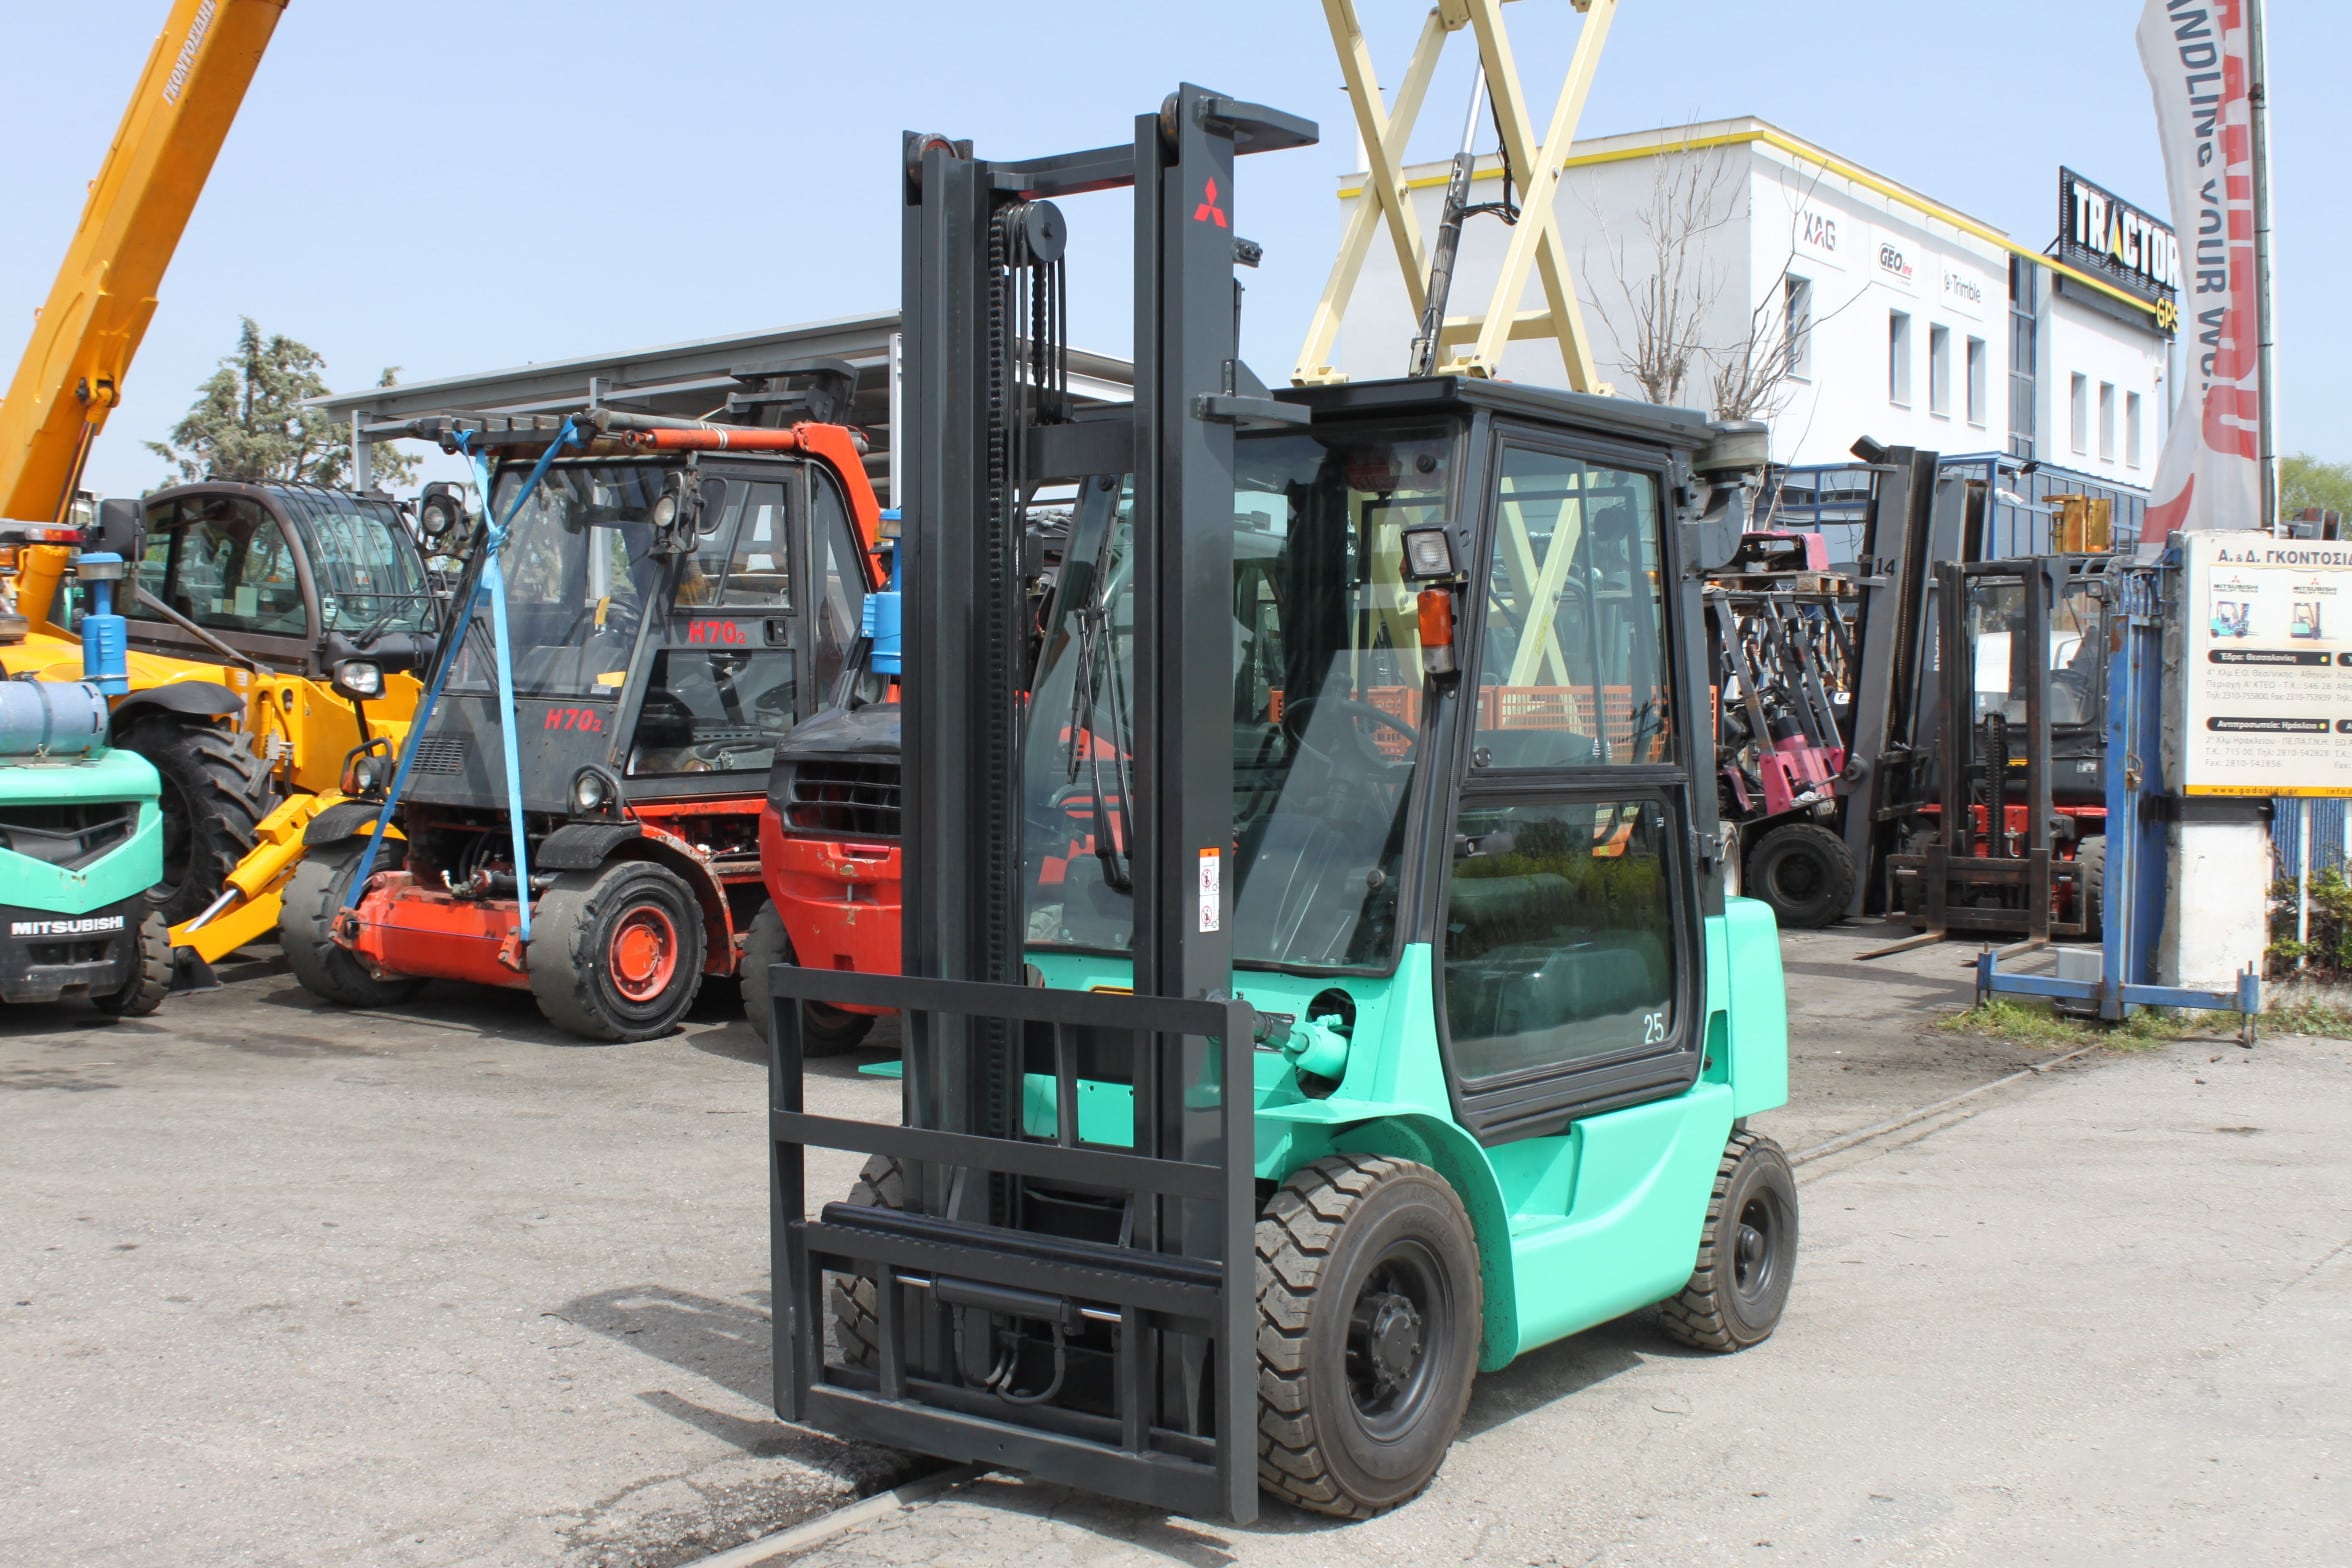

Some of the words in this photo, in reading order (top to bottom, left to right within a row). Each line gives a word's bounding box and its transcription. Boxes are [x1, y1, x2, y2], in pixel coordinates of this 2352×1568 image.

[1803, 209, 1837, 252] XAG
[2073, 181, 2181, 290] TRACTOR
[1879, 246, 1904, 272] GEO
[1952, 273, 1982, 304] Trimble
[2156, 297, 2180, 334] GPS
[1875, 557, 1896, 576] 14
[11, 915, 126, 936] MITSUBISHI
[1643, 1012, 1665, 1045] 25
